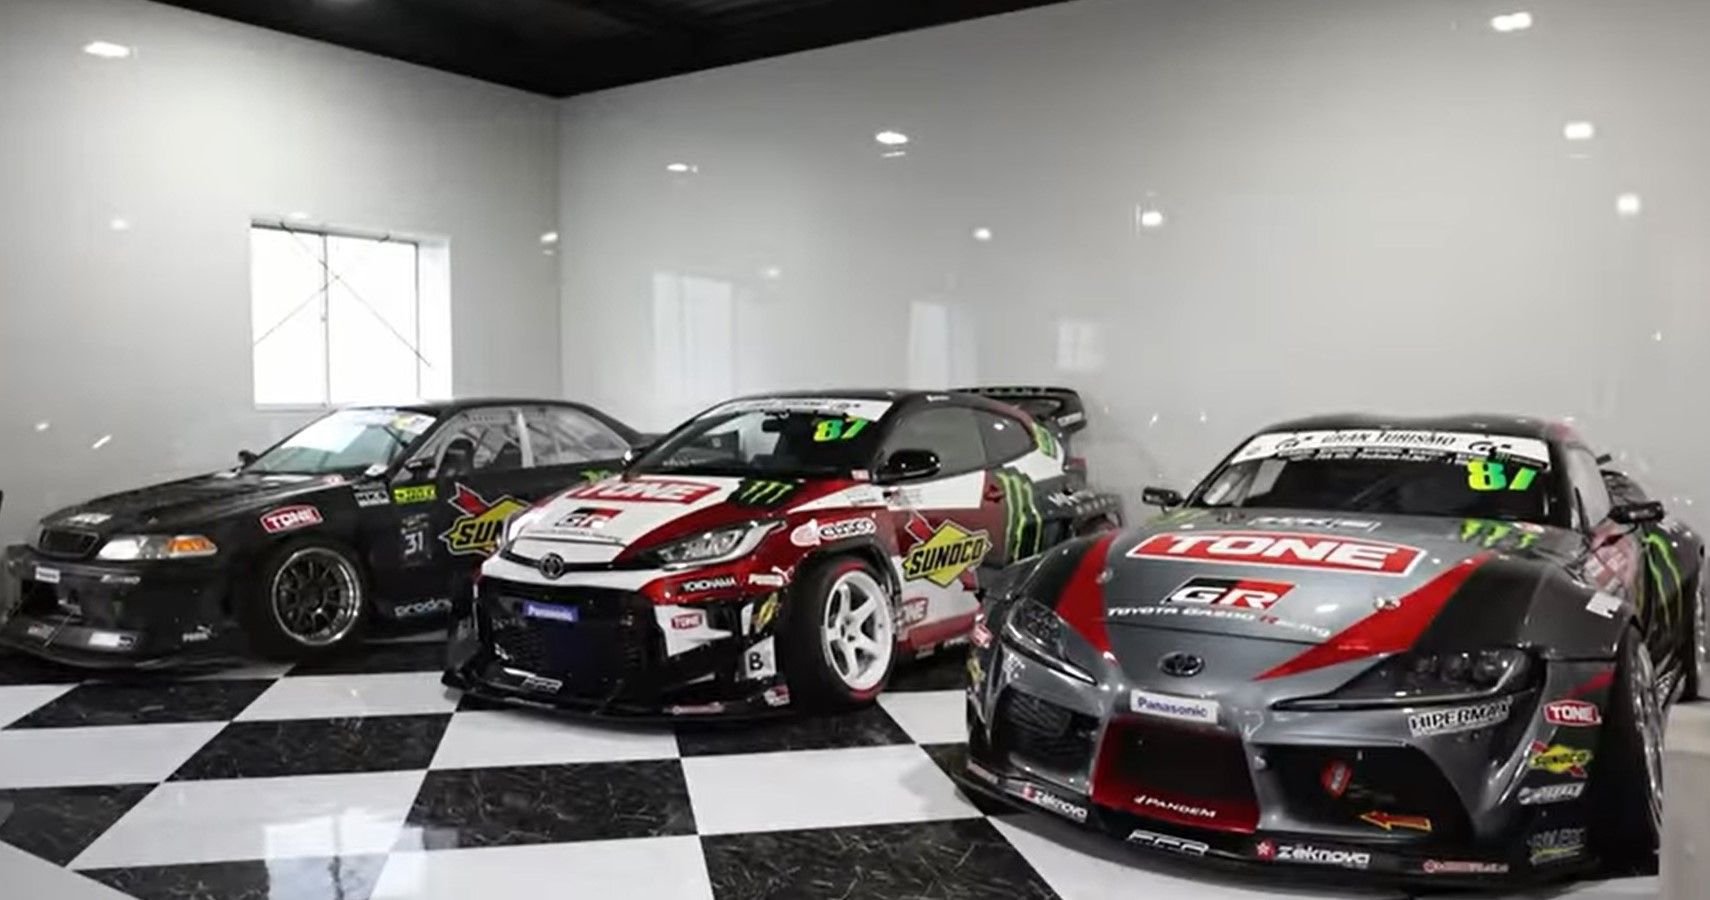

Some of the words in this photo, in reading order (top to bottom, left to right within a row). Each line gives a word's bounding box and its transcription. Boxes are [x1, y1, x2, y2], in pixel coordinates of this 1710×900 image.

[813, 416, 868, 441] 87
[1321, 431, 1371, 444] GRAN
[1375, 431, 1457, 446] TURISMO
[1467, 459, 1537, 491] 87
[266, 508, 318, 529] TONE
[404, 531, 423, 554] 31
[448, 520, 504, 546] SUN
[909, 538, 985, 575] SUNOCO
[1167, 535, 1399, 569] TONE
[680, 577, 736, 592] YOKOHAMA
[1165, 584, 1283, 611] GR
[1107, 605, 1178, 617] TOYOTA
[1182, 607, 1255, 622] GAZOO
[1137, 696, 1209, 718] Panasonic
[1410, 700, 1511, 731] HIPERMAX
[1551, 705, 1594, 723] TONE
[1145, 798, 1217, 818] PANDEM
[1277, 844, 1371, 865] zeknova
